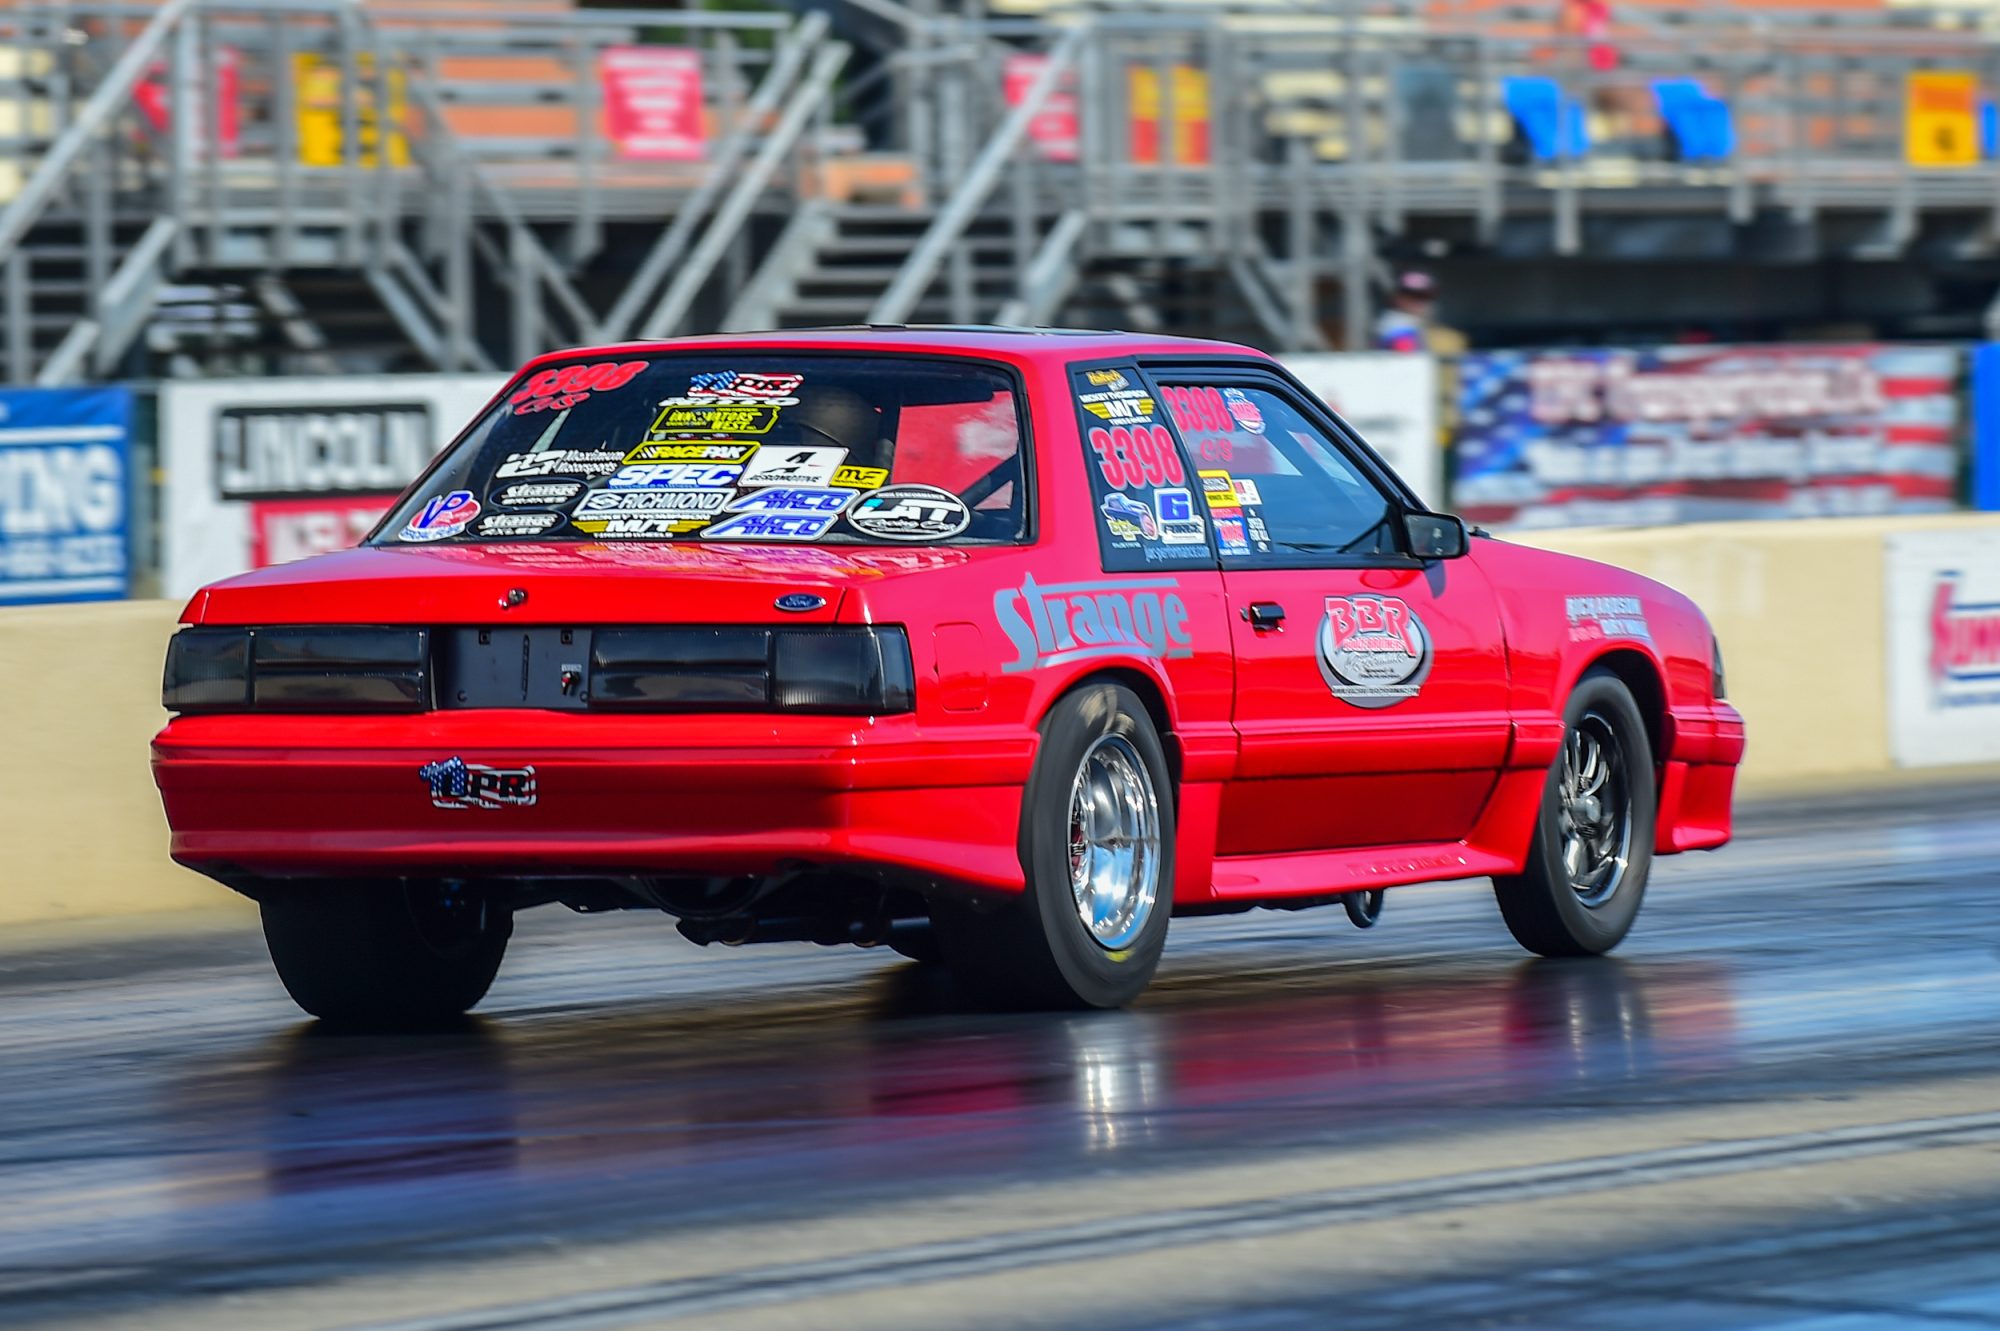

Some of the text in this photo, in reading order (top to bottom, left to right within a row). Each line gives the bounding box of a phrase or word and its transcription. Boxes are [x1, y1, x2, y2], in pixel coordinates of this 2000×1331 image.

[1104, 399, 1143, 418] M/T
[1160, 386, 1234, 433] 3398
[220, 412, 432, 492] LINCOLN
[652, 446, 746, 459] RACEPAK
[1088, 424, 1185, 491] 3398
[609, 465, 743, 486] SPEC
[417, 491, 473, 528] VP
[618, 493, 725, 510] RICHMOND
[606, 520, 678, 532] M/T
[994, 572, 1194, 673] Strange
[1325, 598, 1416, 657] BBR
